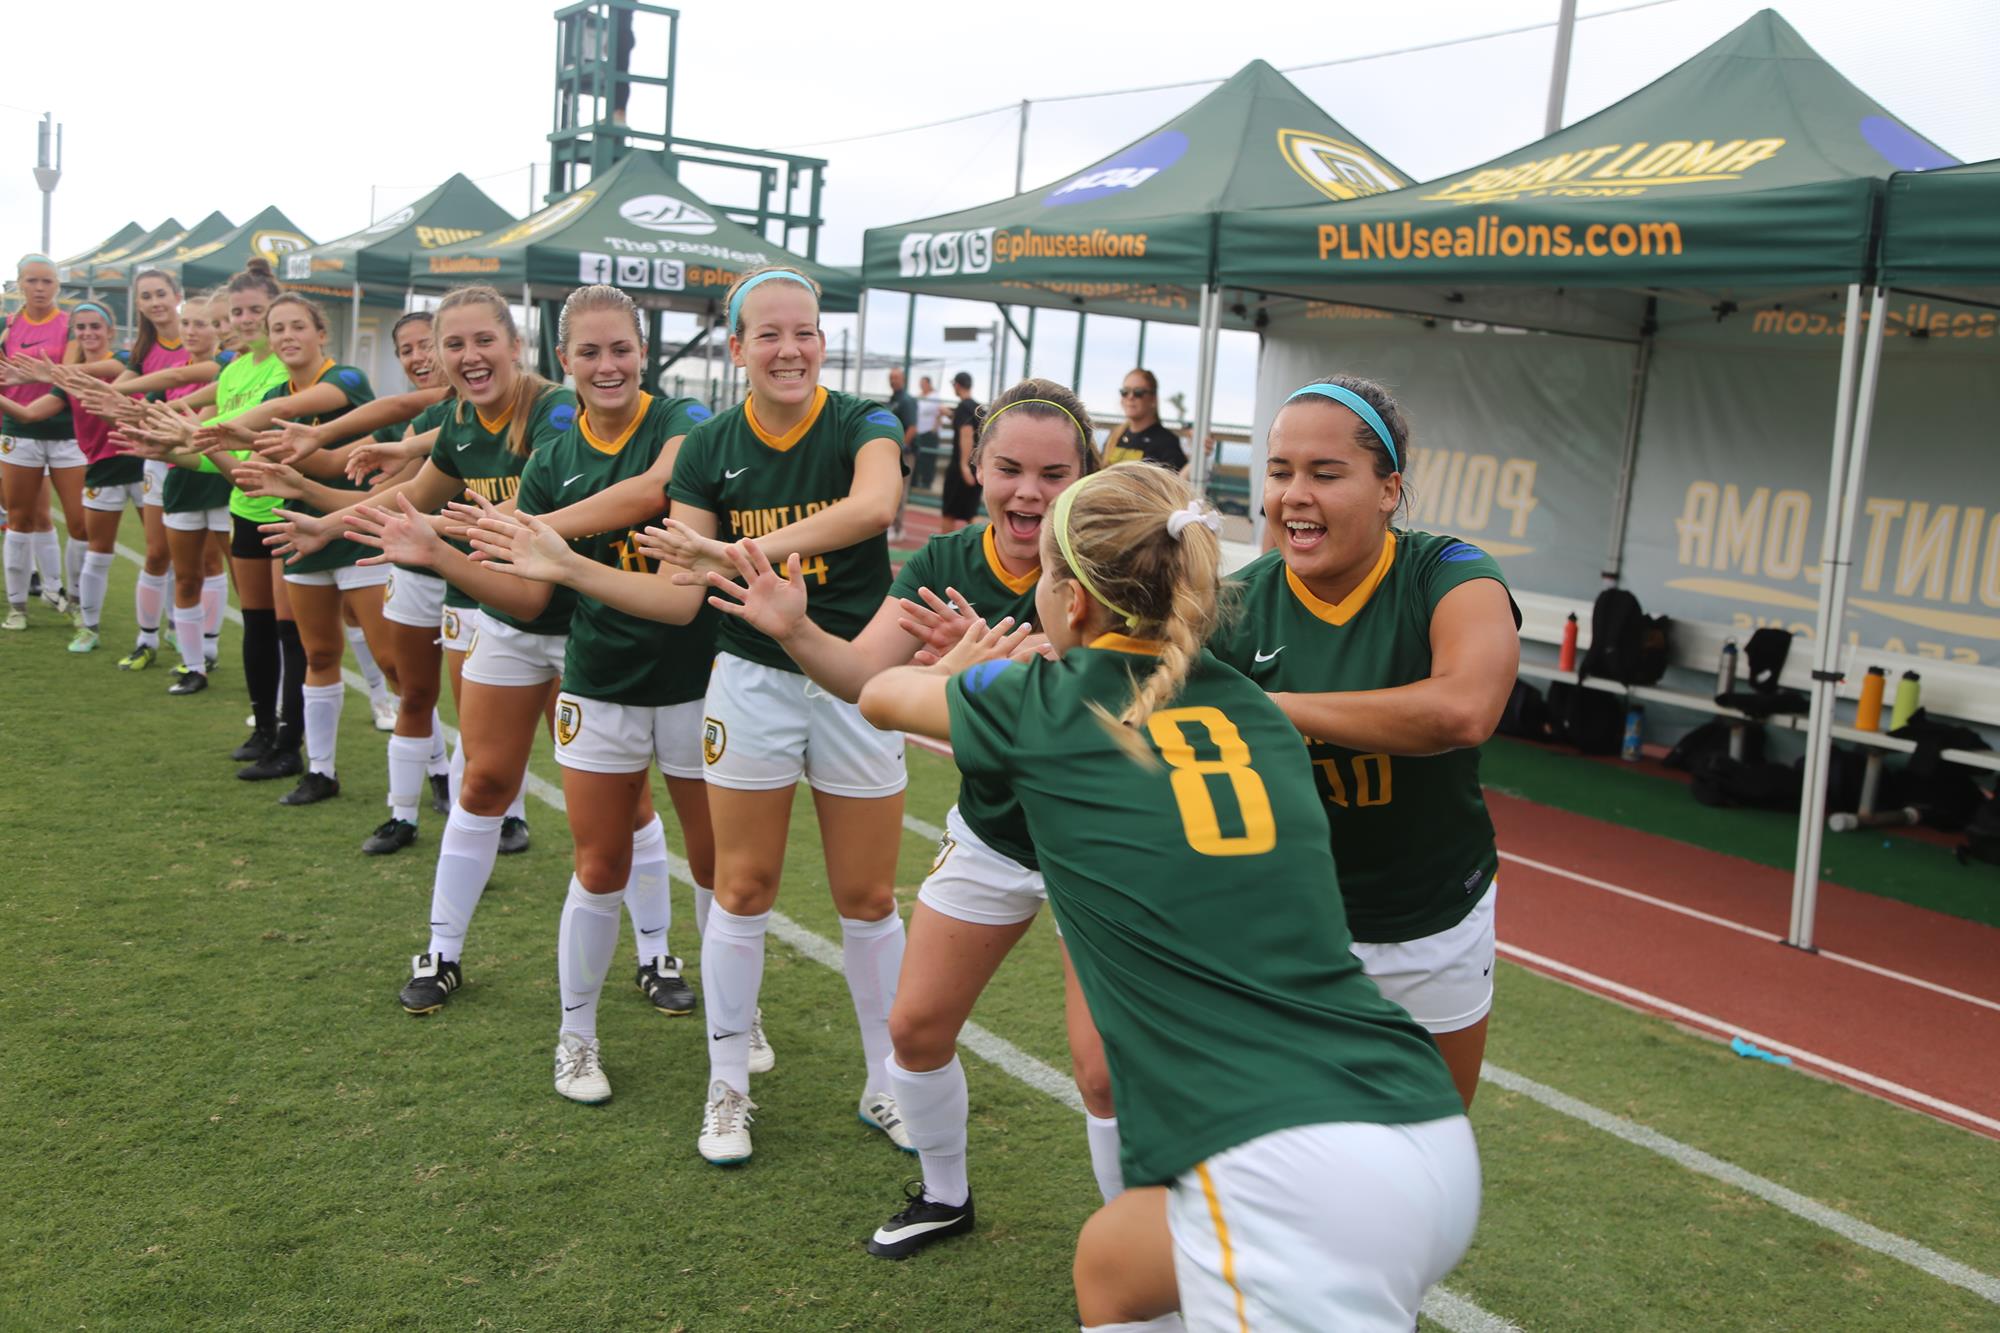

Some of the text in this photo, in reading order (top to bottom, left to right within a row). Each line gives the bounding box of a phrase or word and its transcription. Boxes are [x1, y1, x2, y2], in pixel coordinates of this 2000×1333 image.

[1591, 138, 1786, 179] LOMA
[416, 215, 484, 249] POI
[604, 236, 658, 254] The
[992, 227, 1148, 264] @plnusealions
[1317, 215, 1683, 261] PLNUsealions.com
[686, 266, 738, 288] @pln
[729, 505, 790, 538] POINT
[1146, 705, 1278, 857] 8
[1311, 753, 1393, 808] 10
